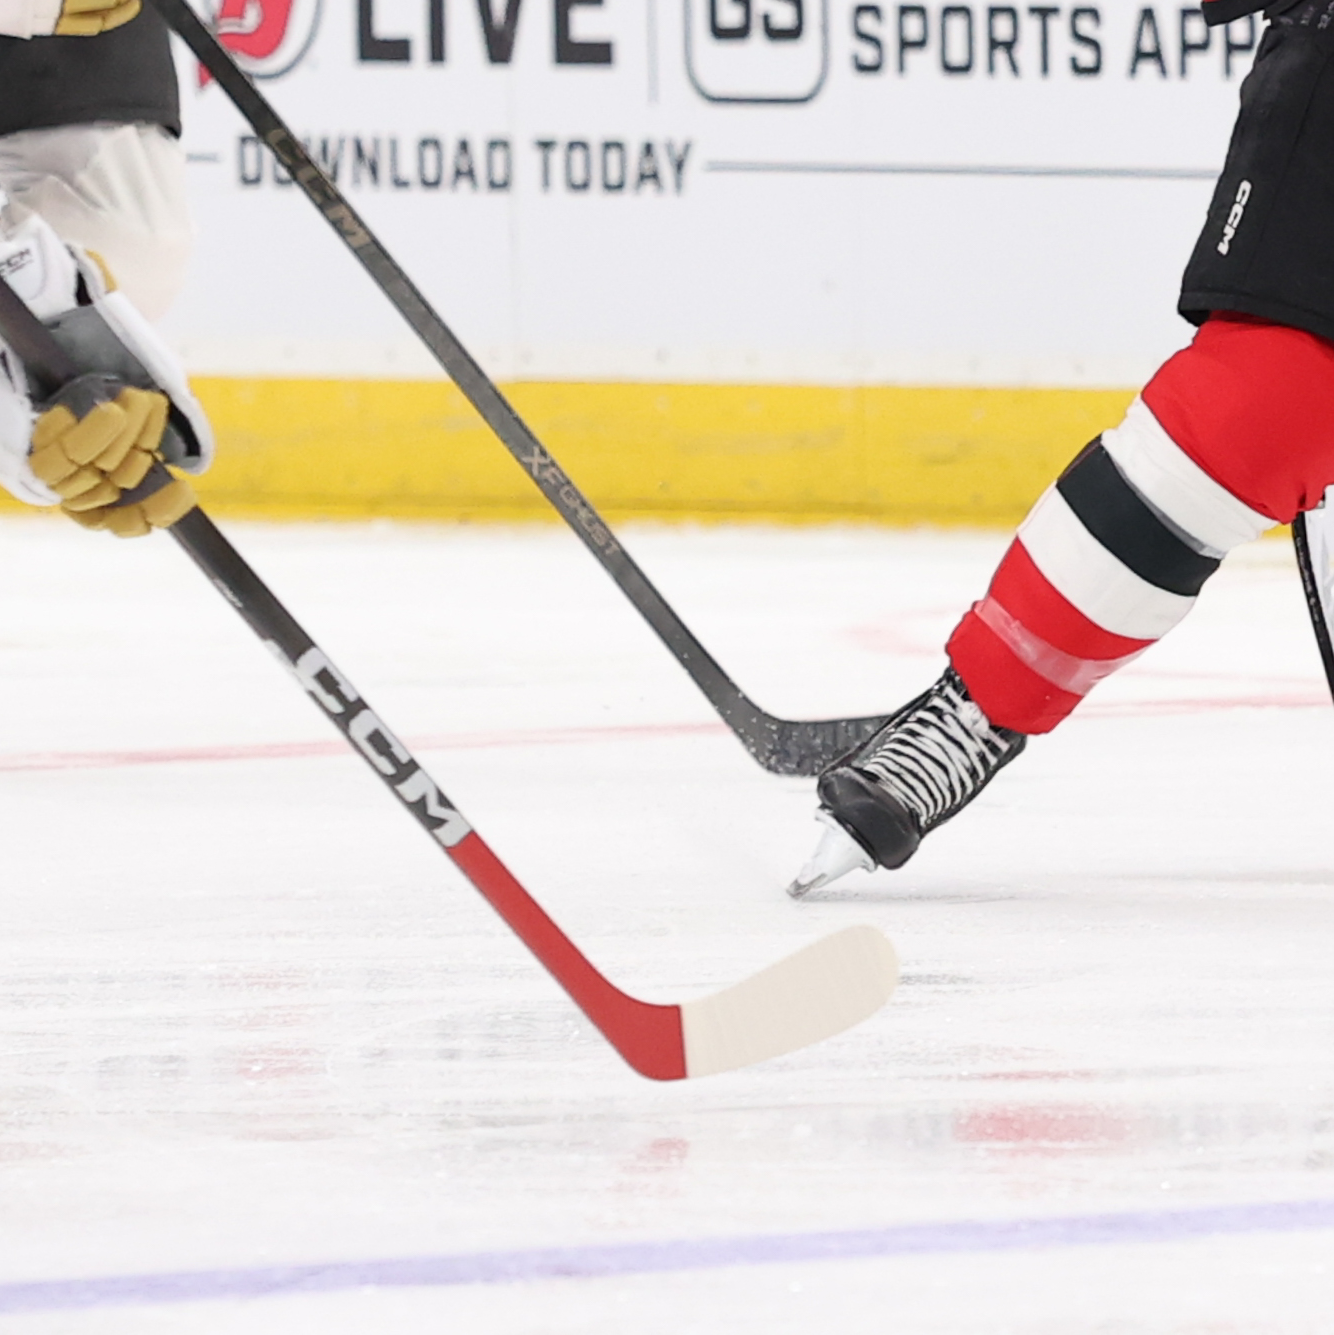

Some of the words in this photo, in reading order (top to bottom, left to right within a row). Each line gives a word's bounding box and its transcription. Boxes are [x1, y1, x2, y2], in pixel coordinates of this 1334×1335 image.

[852, 5, 1103, 75] SPORTS
[1129, 7, 1257, 78] APP
[535, 140, 693, 194] TODAY
[1217, 179, 1252, 256] CCM
[267, 641, 474, 848] CCM
